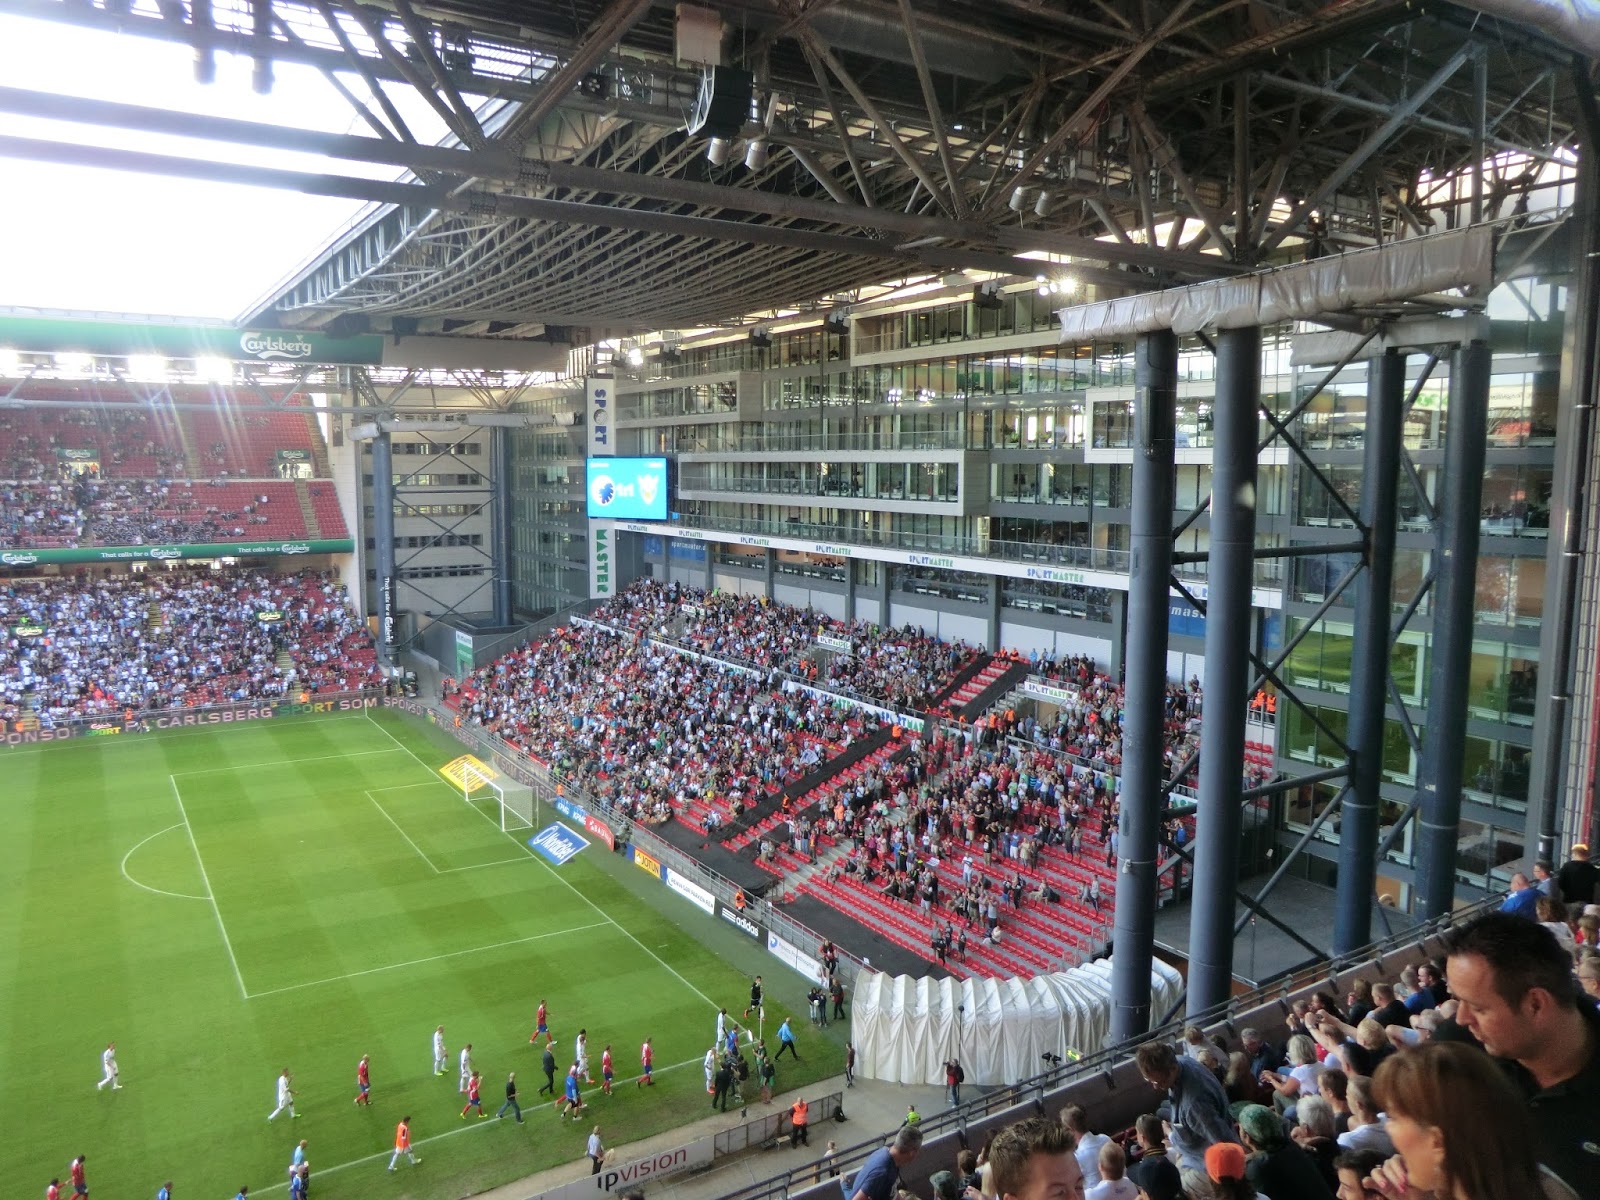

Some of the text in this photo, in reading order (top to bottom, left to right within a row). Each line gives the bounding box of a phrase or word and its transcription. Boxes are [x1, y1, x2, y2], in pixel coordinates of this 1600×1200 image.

[240, 332, 312, 359] Carlsberg
[593, 389, 608, 445] SPORT
[150, 548, 182, 559] Carlsberg
[281, 543, 310, 554] Carlsberg
[2, 552, 38, 565] Carlsberg
[596, 529, 608, 593] MASTER
[909, 555, 954, 567] SPORTMASTER
[1027, 568, 1084, 583] SPORTMASTER
[157, 707, 272, 729] CARLSBERG
[278, 701, 334, 716] SPORT
[340, 697, 377, 711] SOM
[641, 856, 659, 873] JOTUN
[736, 916, 759, 937] adidas
